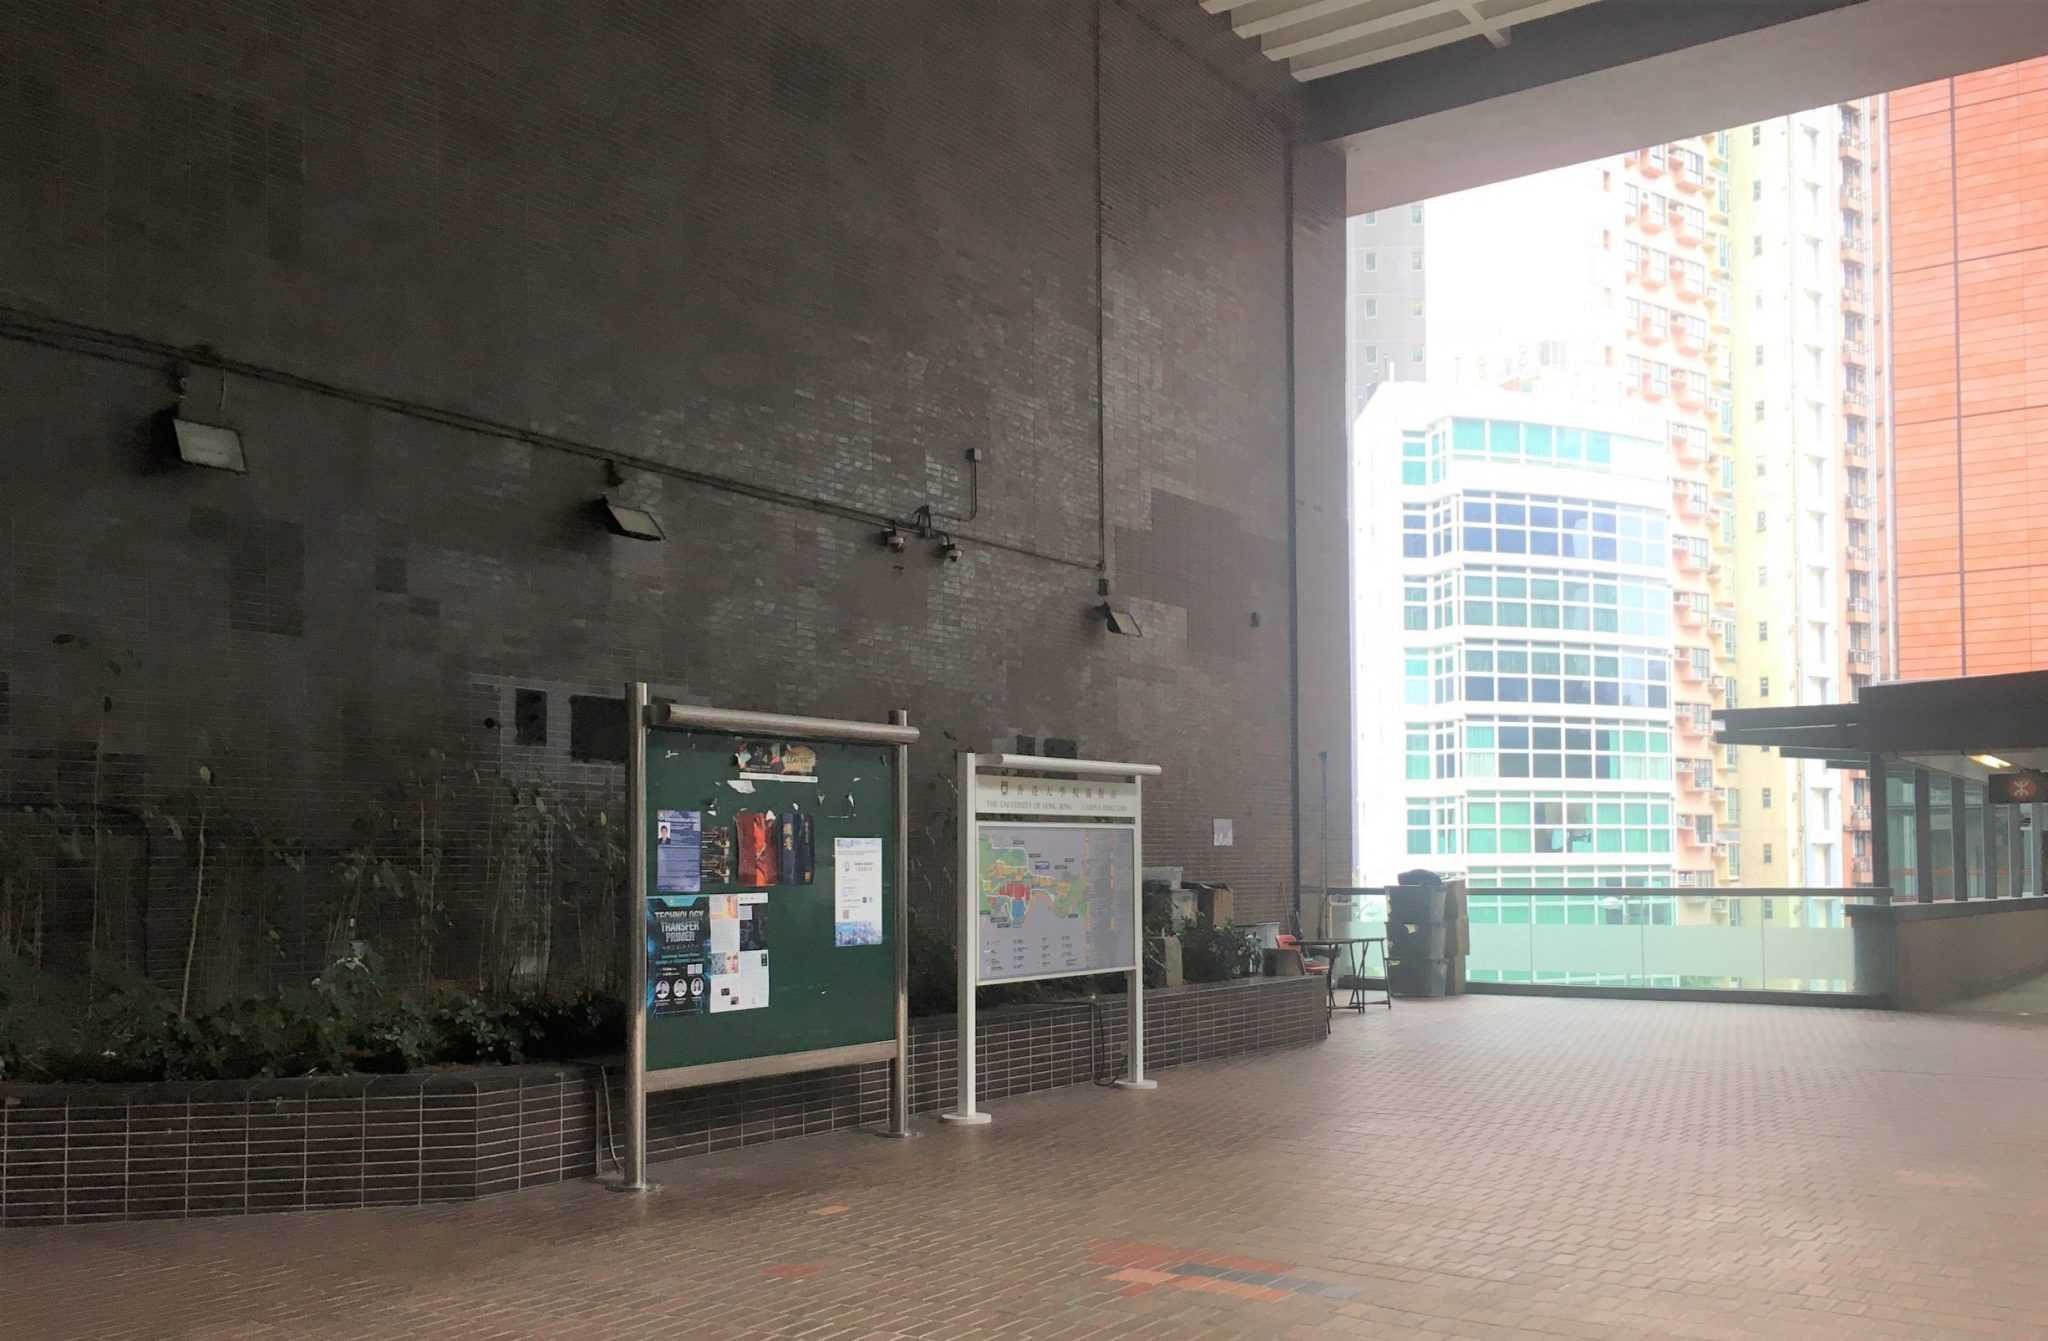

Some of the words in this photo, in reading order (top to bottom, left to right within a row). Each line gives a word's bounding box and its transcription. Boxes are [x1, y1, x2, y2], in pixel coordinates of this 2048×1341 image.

[985, 800, 998, 808] THE
[1000, 801, 1032, 809] UNIVERSITY
[1042, 802, 1058, 810] HONG
[1059, 802, 1074, 810] KONG
[654, 910, 704, 922] TECHNOLOGY
[661, 921, 700, 933] TRANSFER
[665, 931, 696, 943] PRIMER
